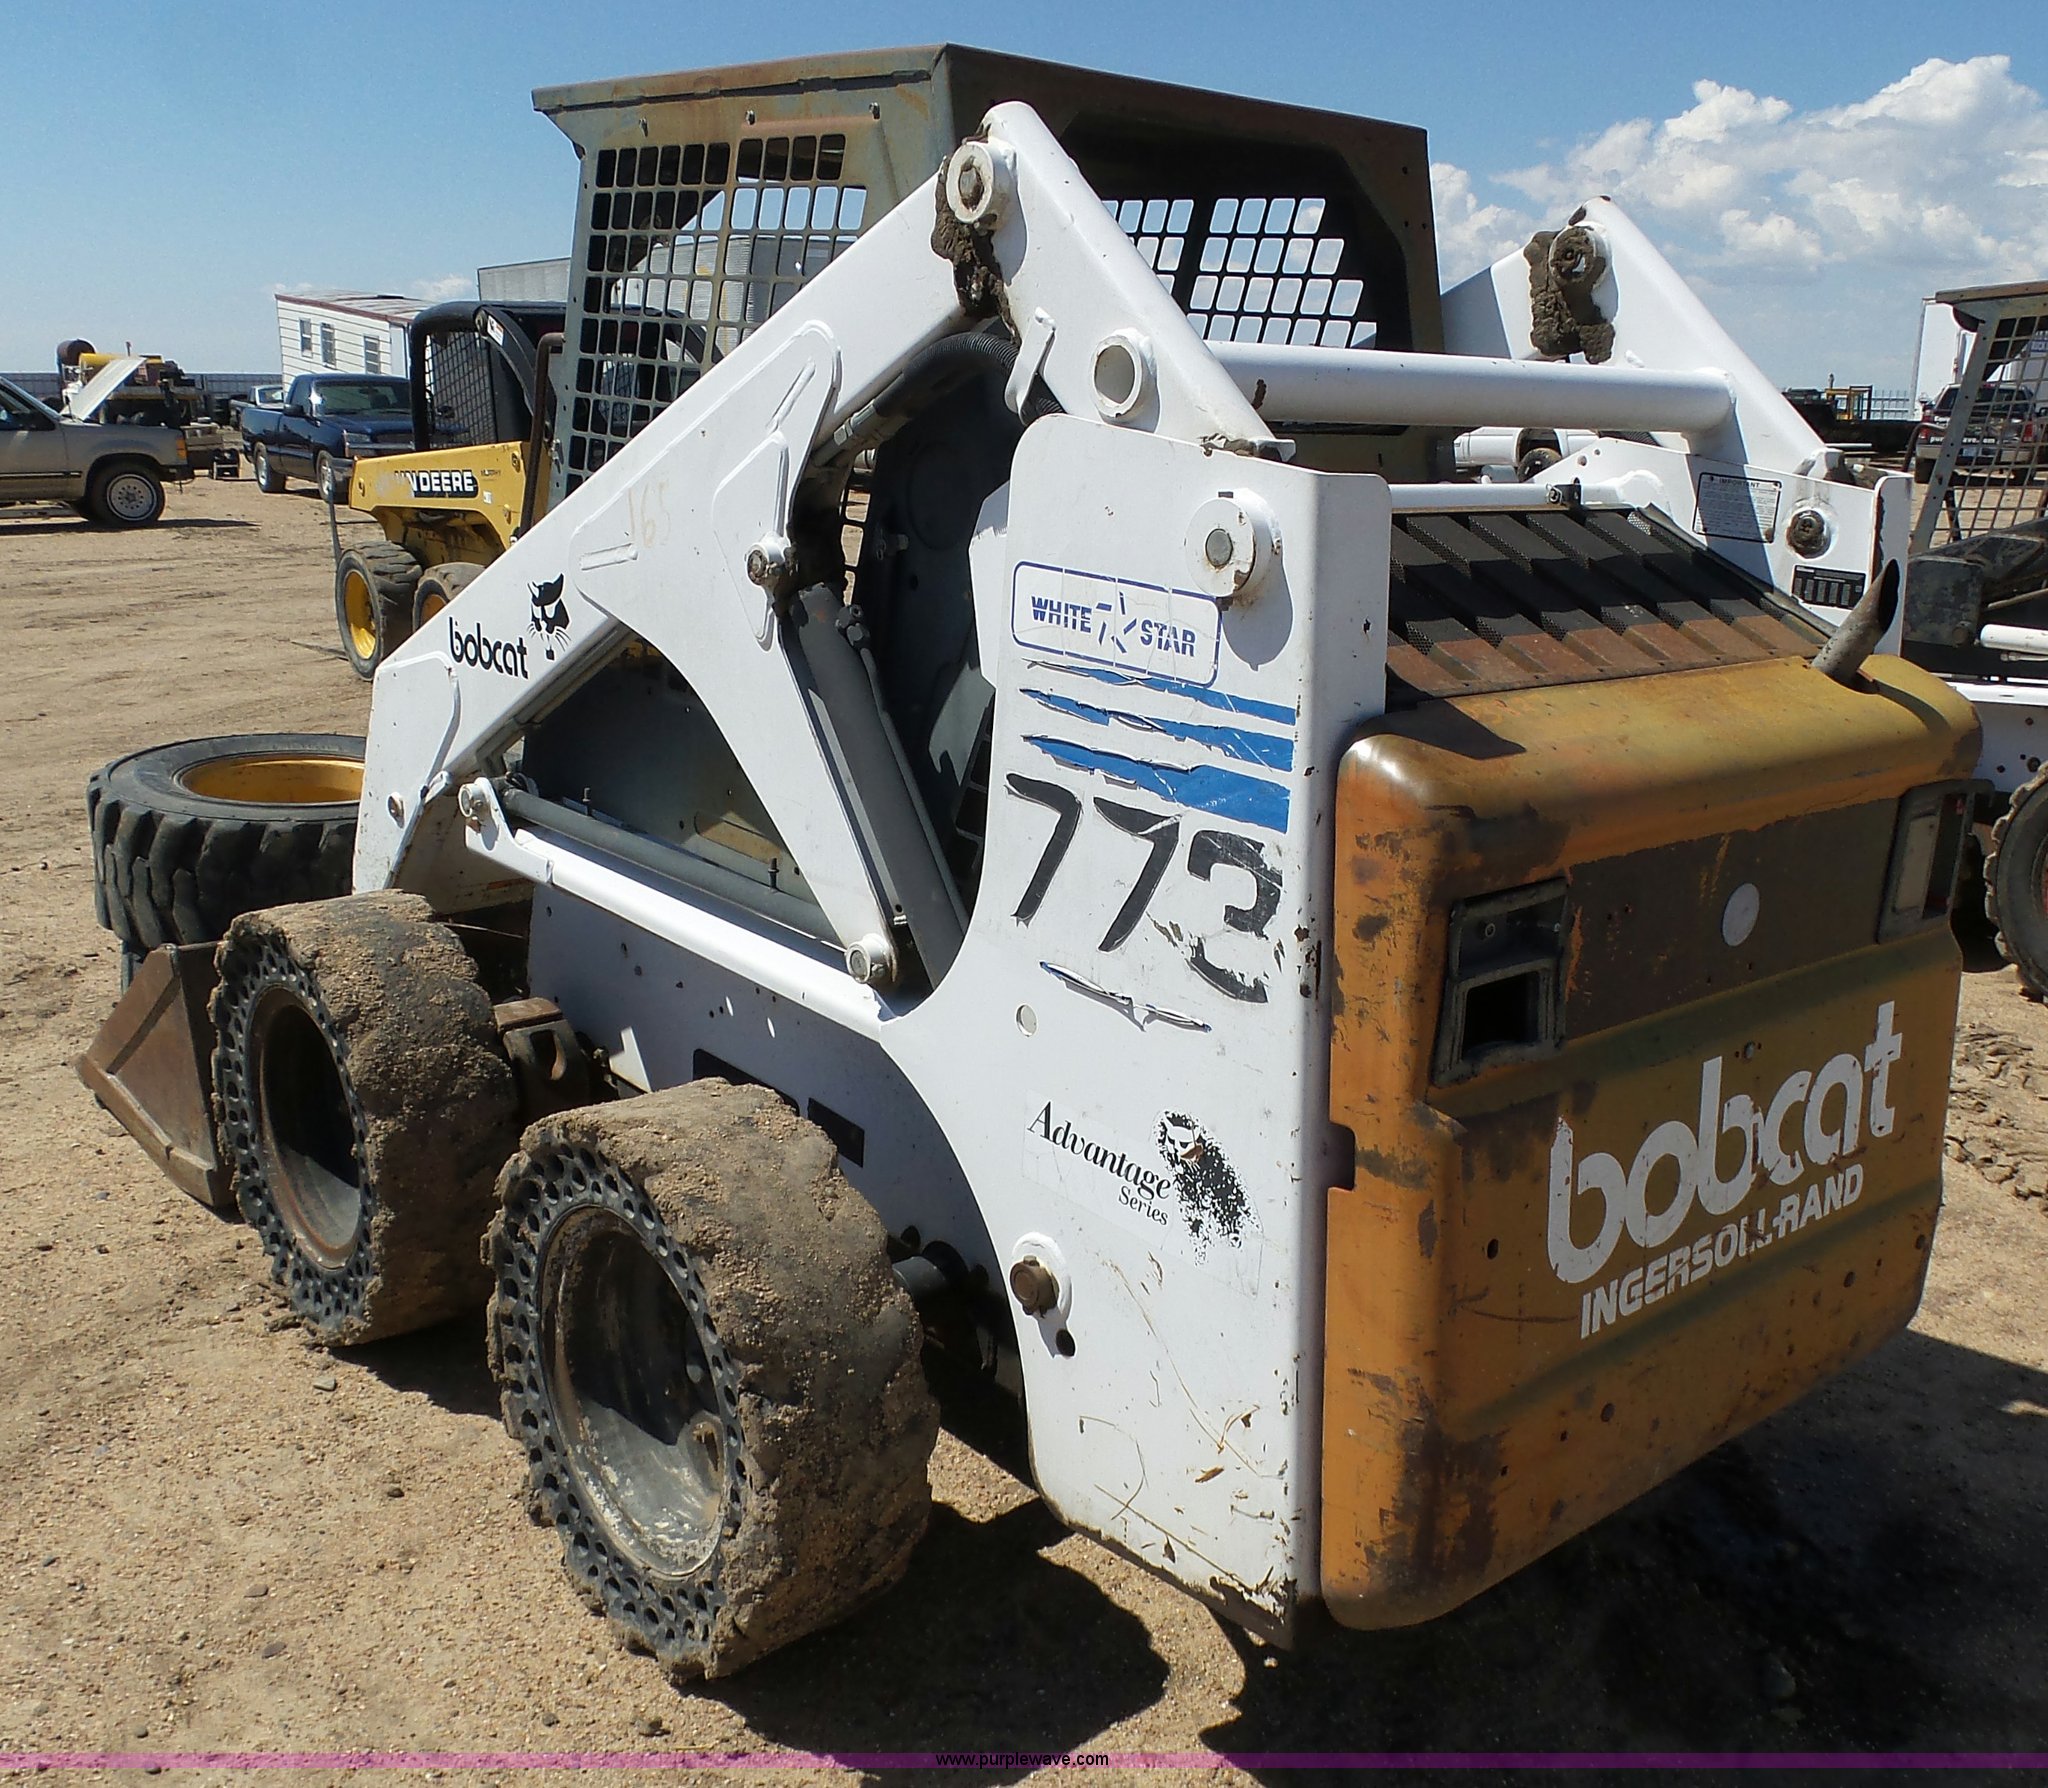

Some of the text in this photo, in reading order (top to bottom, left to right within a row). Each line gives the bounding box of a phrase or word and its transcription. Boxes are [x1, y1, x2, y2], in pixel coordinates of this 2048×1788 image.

[419, 470, 475, 493] DEERE
[448, 616, 529, 680] bobcat
[1030, 595, 1197, 658] WHITE STAR
[1004, 772, 1284, 1004] 773
[1026, 1100, 1172, 1201] Advantage
[1546, 1000, 1903, 1284] bobcat
[1118, 1185, 1169, 1227] Series
